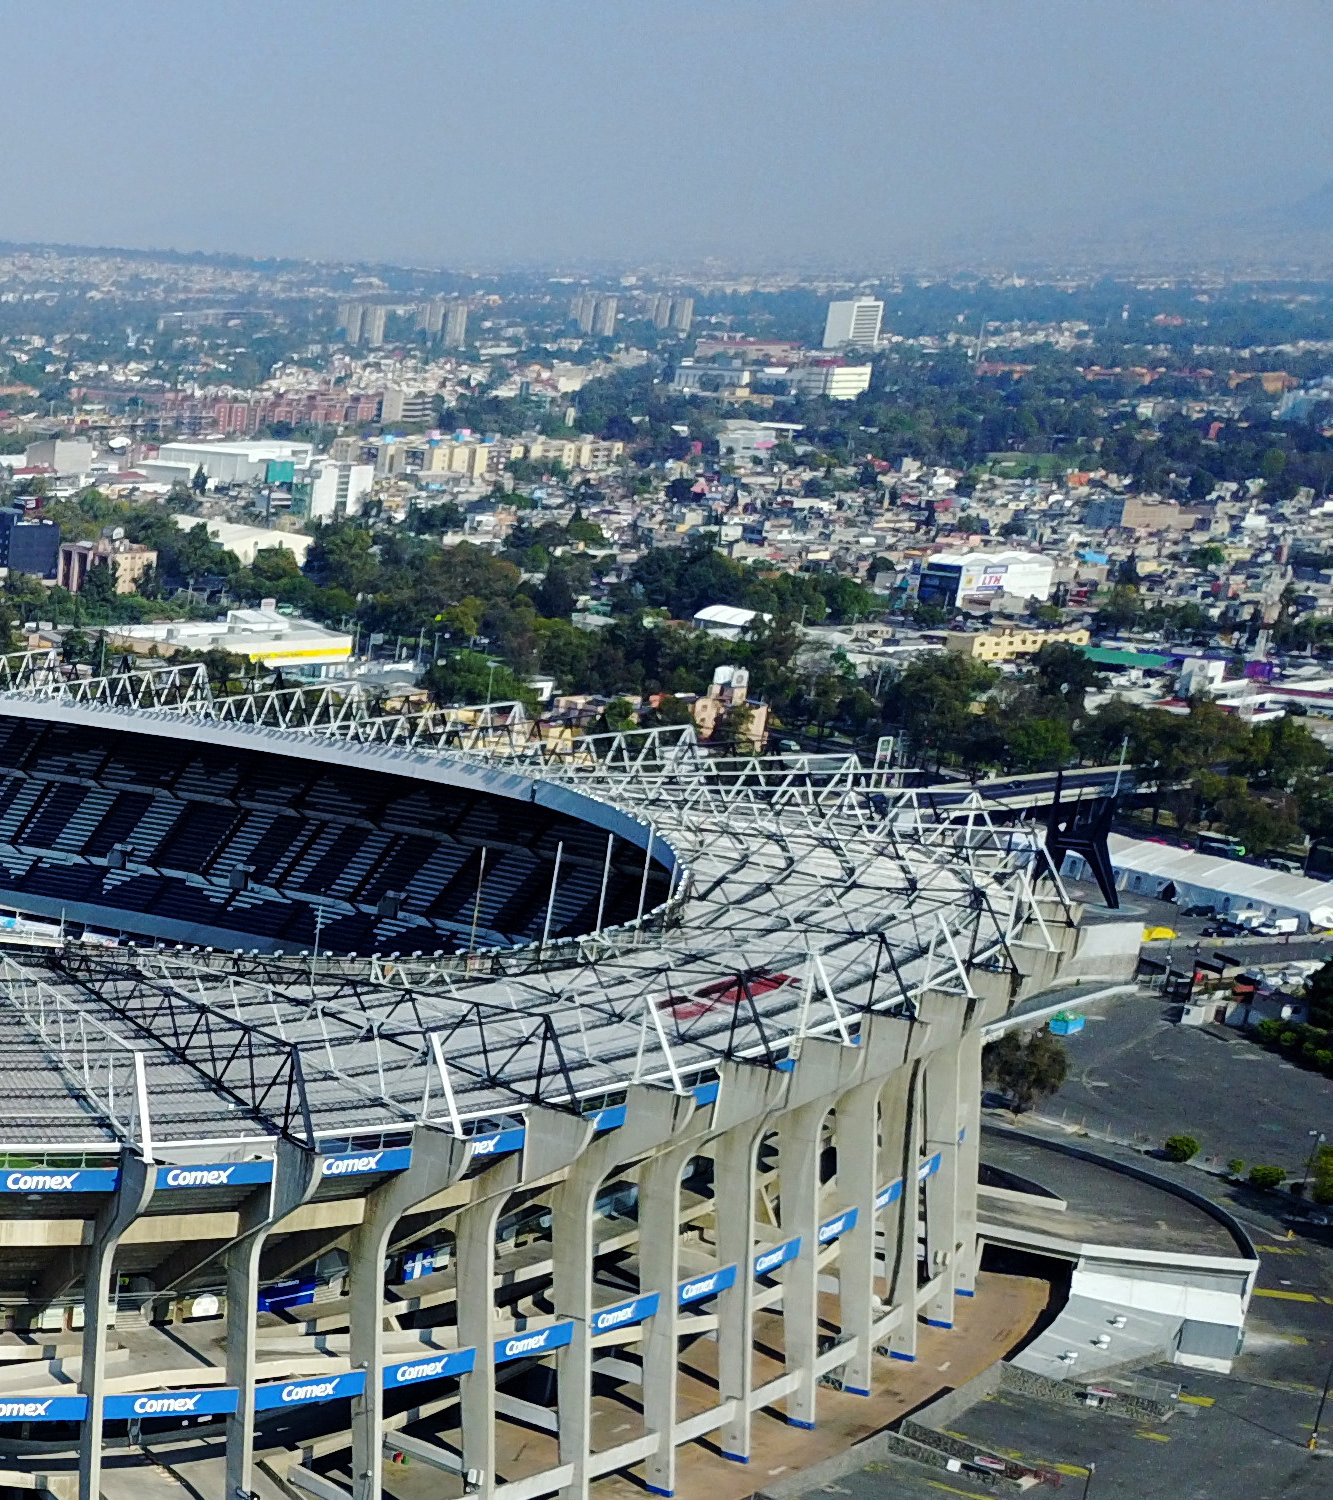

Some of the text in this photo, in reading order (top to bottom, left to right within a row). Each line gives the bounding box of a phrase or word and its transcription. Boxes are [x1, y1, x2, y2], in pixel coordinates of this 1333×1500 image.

[322, 1152, 383, 1175] Comex
[7, 1172, 80, 1190] Comex
[167, 1167, 235, 1186] Comex
[683, 1274, 717, 1299] Comex
[597, 1304, 635, 1328] Comex
[505, 1330, 549, 1356] Comex
[396, 1357, 448, 1382] Comex
[282, 1378, 340, 1401] Comex
[134, 1394, 201, 1414] Comex
